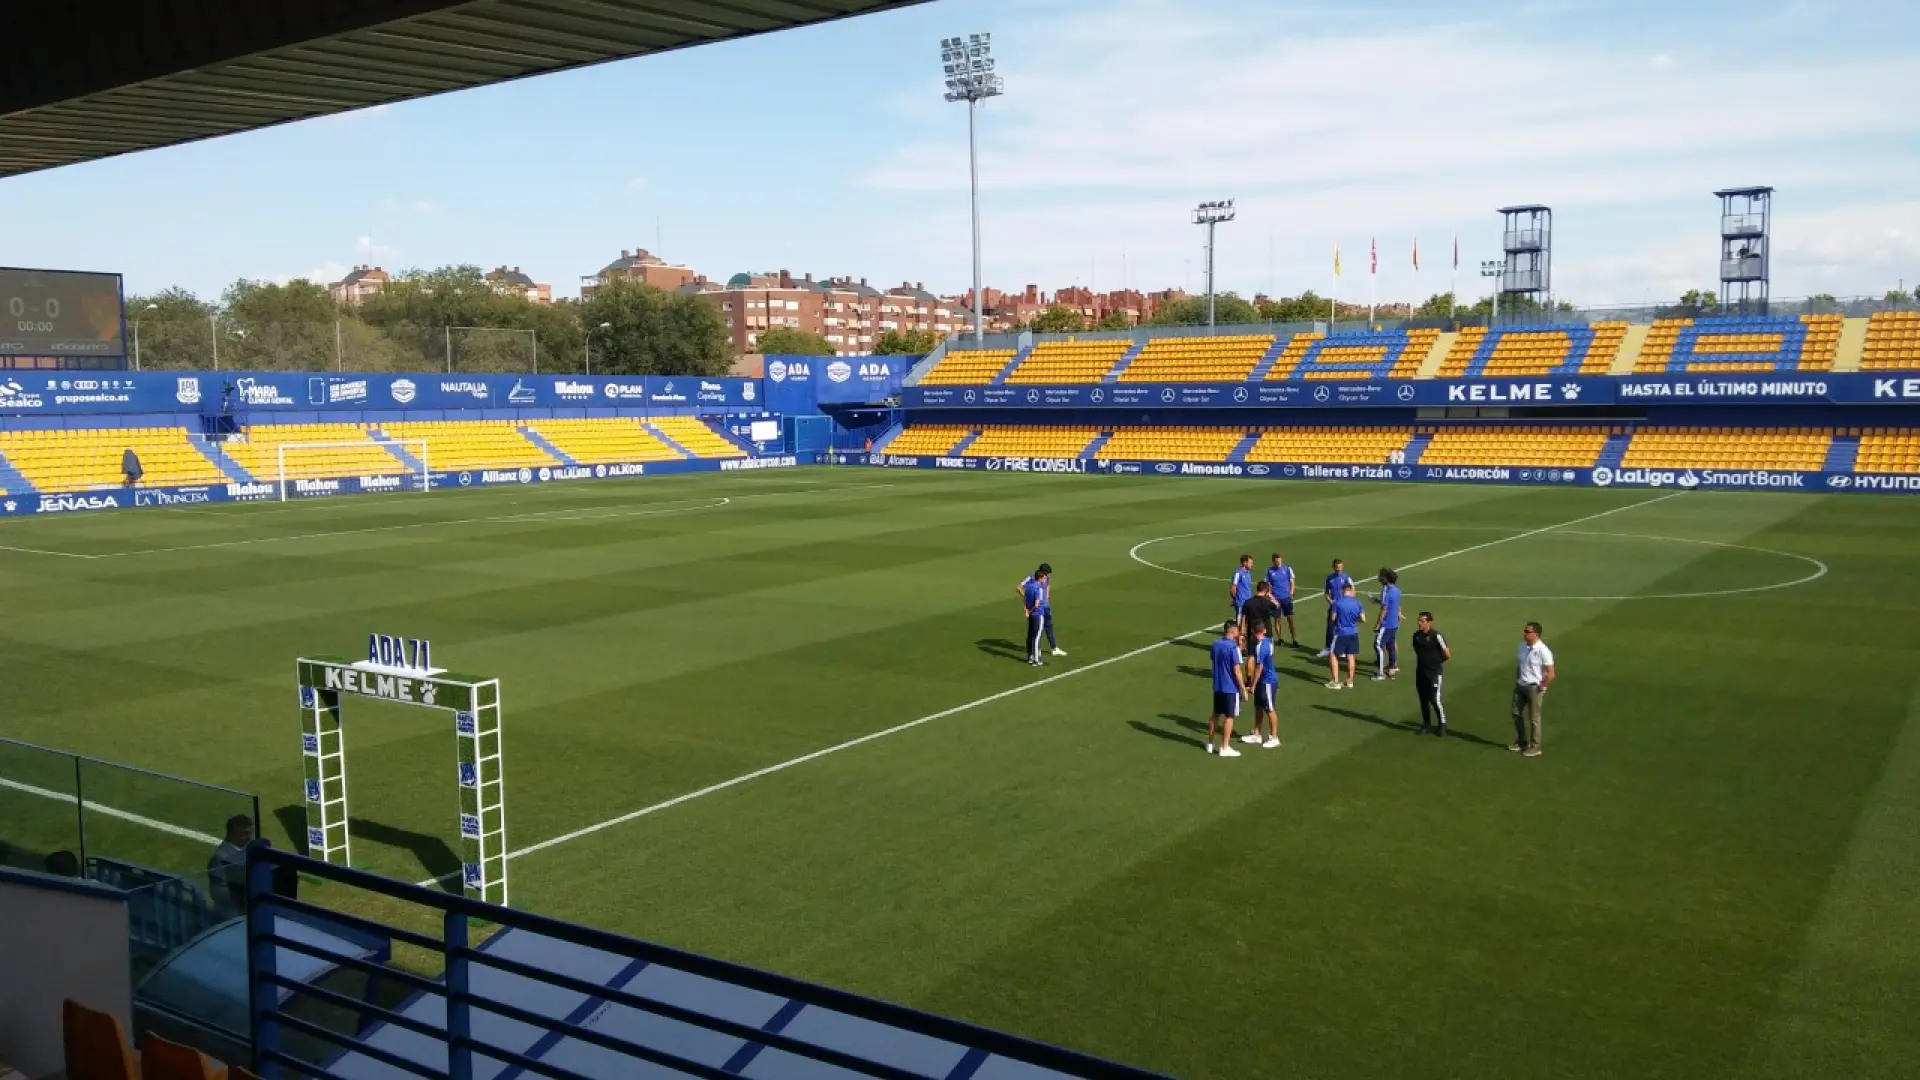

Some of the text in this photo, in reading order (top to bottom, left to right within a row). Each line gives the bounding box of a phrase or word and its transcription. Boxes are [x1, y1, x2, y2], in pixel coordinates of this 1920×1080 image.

[9, 297, 25, 317] 0
[45, 297, 60, 318] 0
[17, 320, 54, 333] 00:00
[788, 362, 811, 376] ADA
[859, 363, 891, 376] ADA
[441, 381, 487, 392] NAUTALIA
[1449, 383, 1552, 400] KELME
[1621, 379, 1828, 397] HASTA EL ÚLTIMO MINUTO
[609, 465, 643, 475] ALKOR
[1005, 458, 1087, 473] FIRE CONSULT
[1181, 462, 1243, 475] Almoauto
[1301, 464, 1393, 478] Talleres Prizán
[482, 471, 517, 483] Allianz
[1426, 467, 1510, 480] AD ALCORCÓN
[1615, 469, 1675, 487] LaLiga
[1702, 470, 1804, 487] SmartBank
[296, 478, 339, 492] Mahou
[360, 475, 400, 488] Mahou
[227, 482, 273, 496] Mahou
[36, 496, 119, 512] JENASA
[135, 493, 151, 506] LA
[158, 491, 209, 505] PRINCESA
[368, 633, 431, 672] ADA 71
[325, 666, 413, 702] KELME
